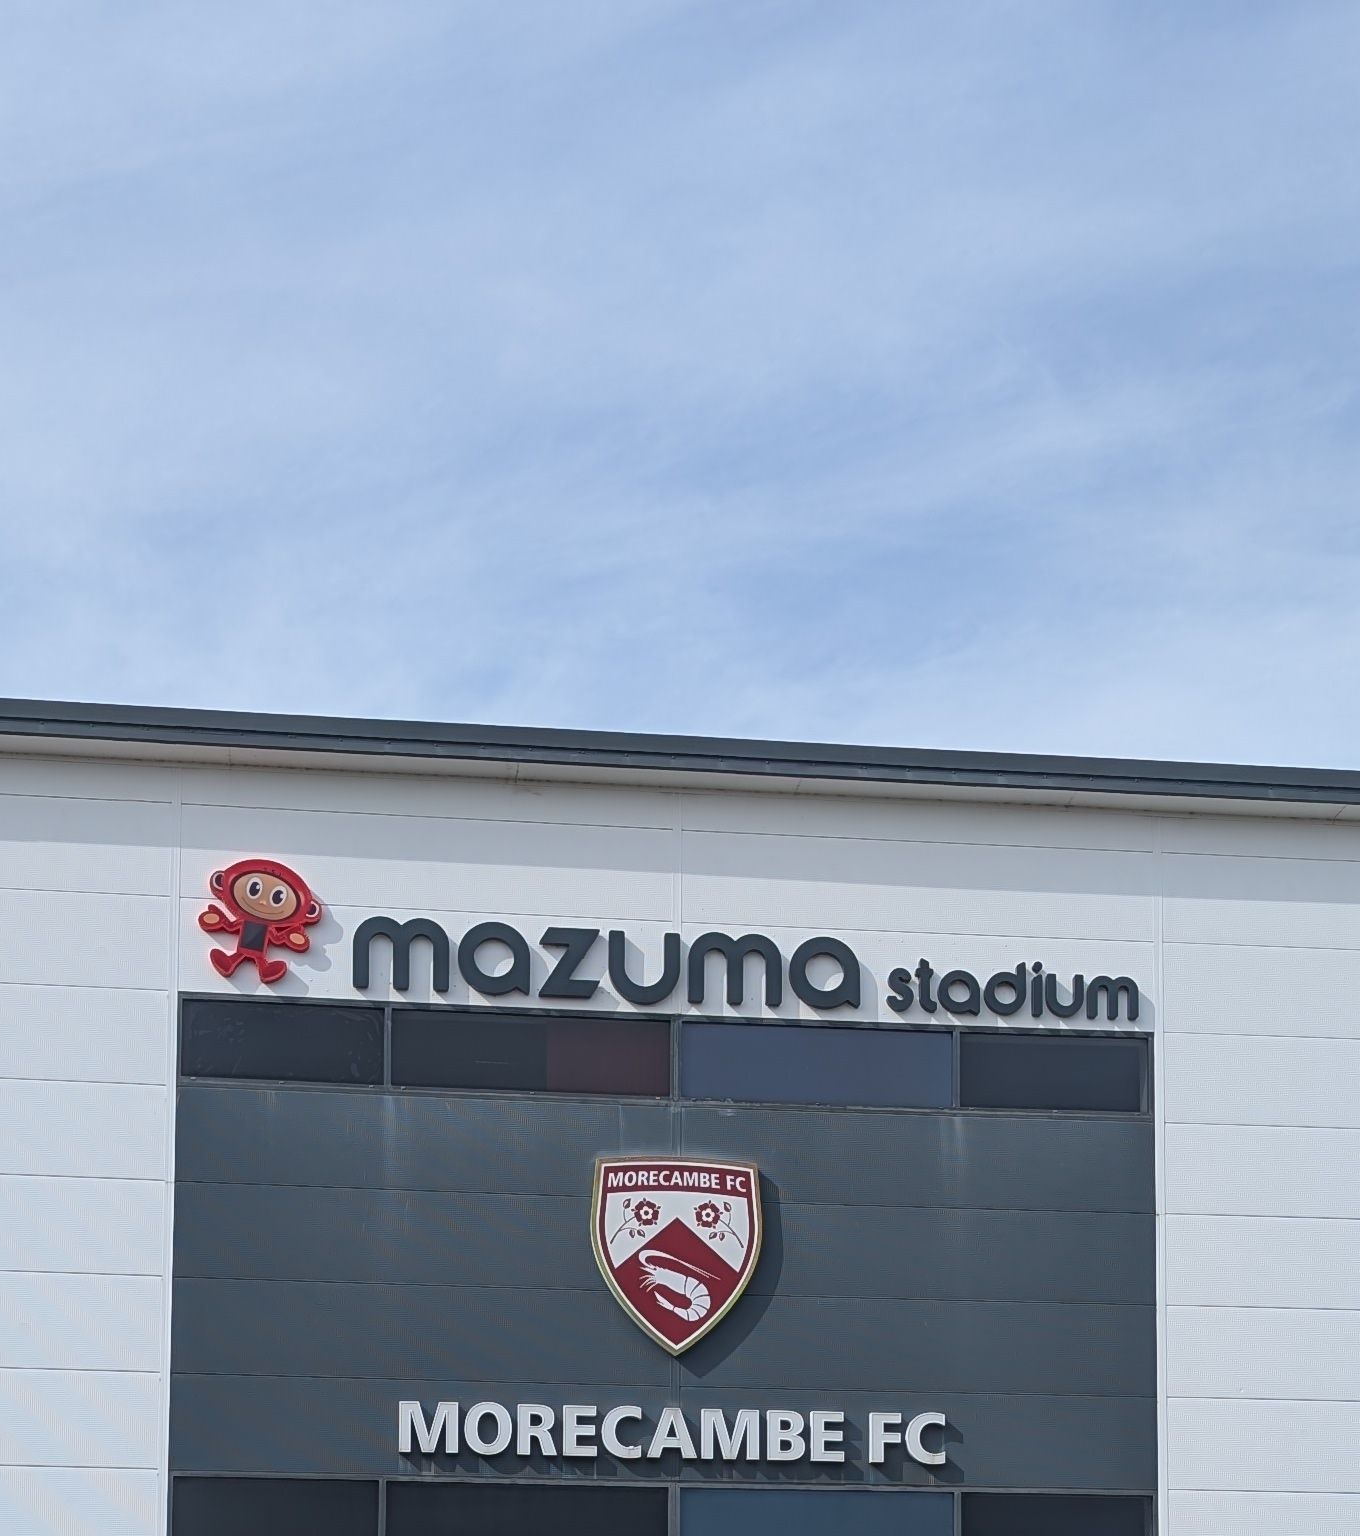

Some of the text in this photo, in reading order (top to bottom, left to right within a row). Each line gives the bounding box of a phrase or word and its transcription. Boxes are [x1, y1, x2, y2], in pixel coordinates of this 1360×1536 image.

[353, 916, 1140, 1021] mazuma stadium
[607, 1171, 747, 1192] MORECAMBE FC
[398, 1401, 947, 1465] MORECAMBE FC
